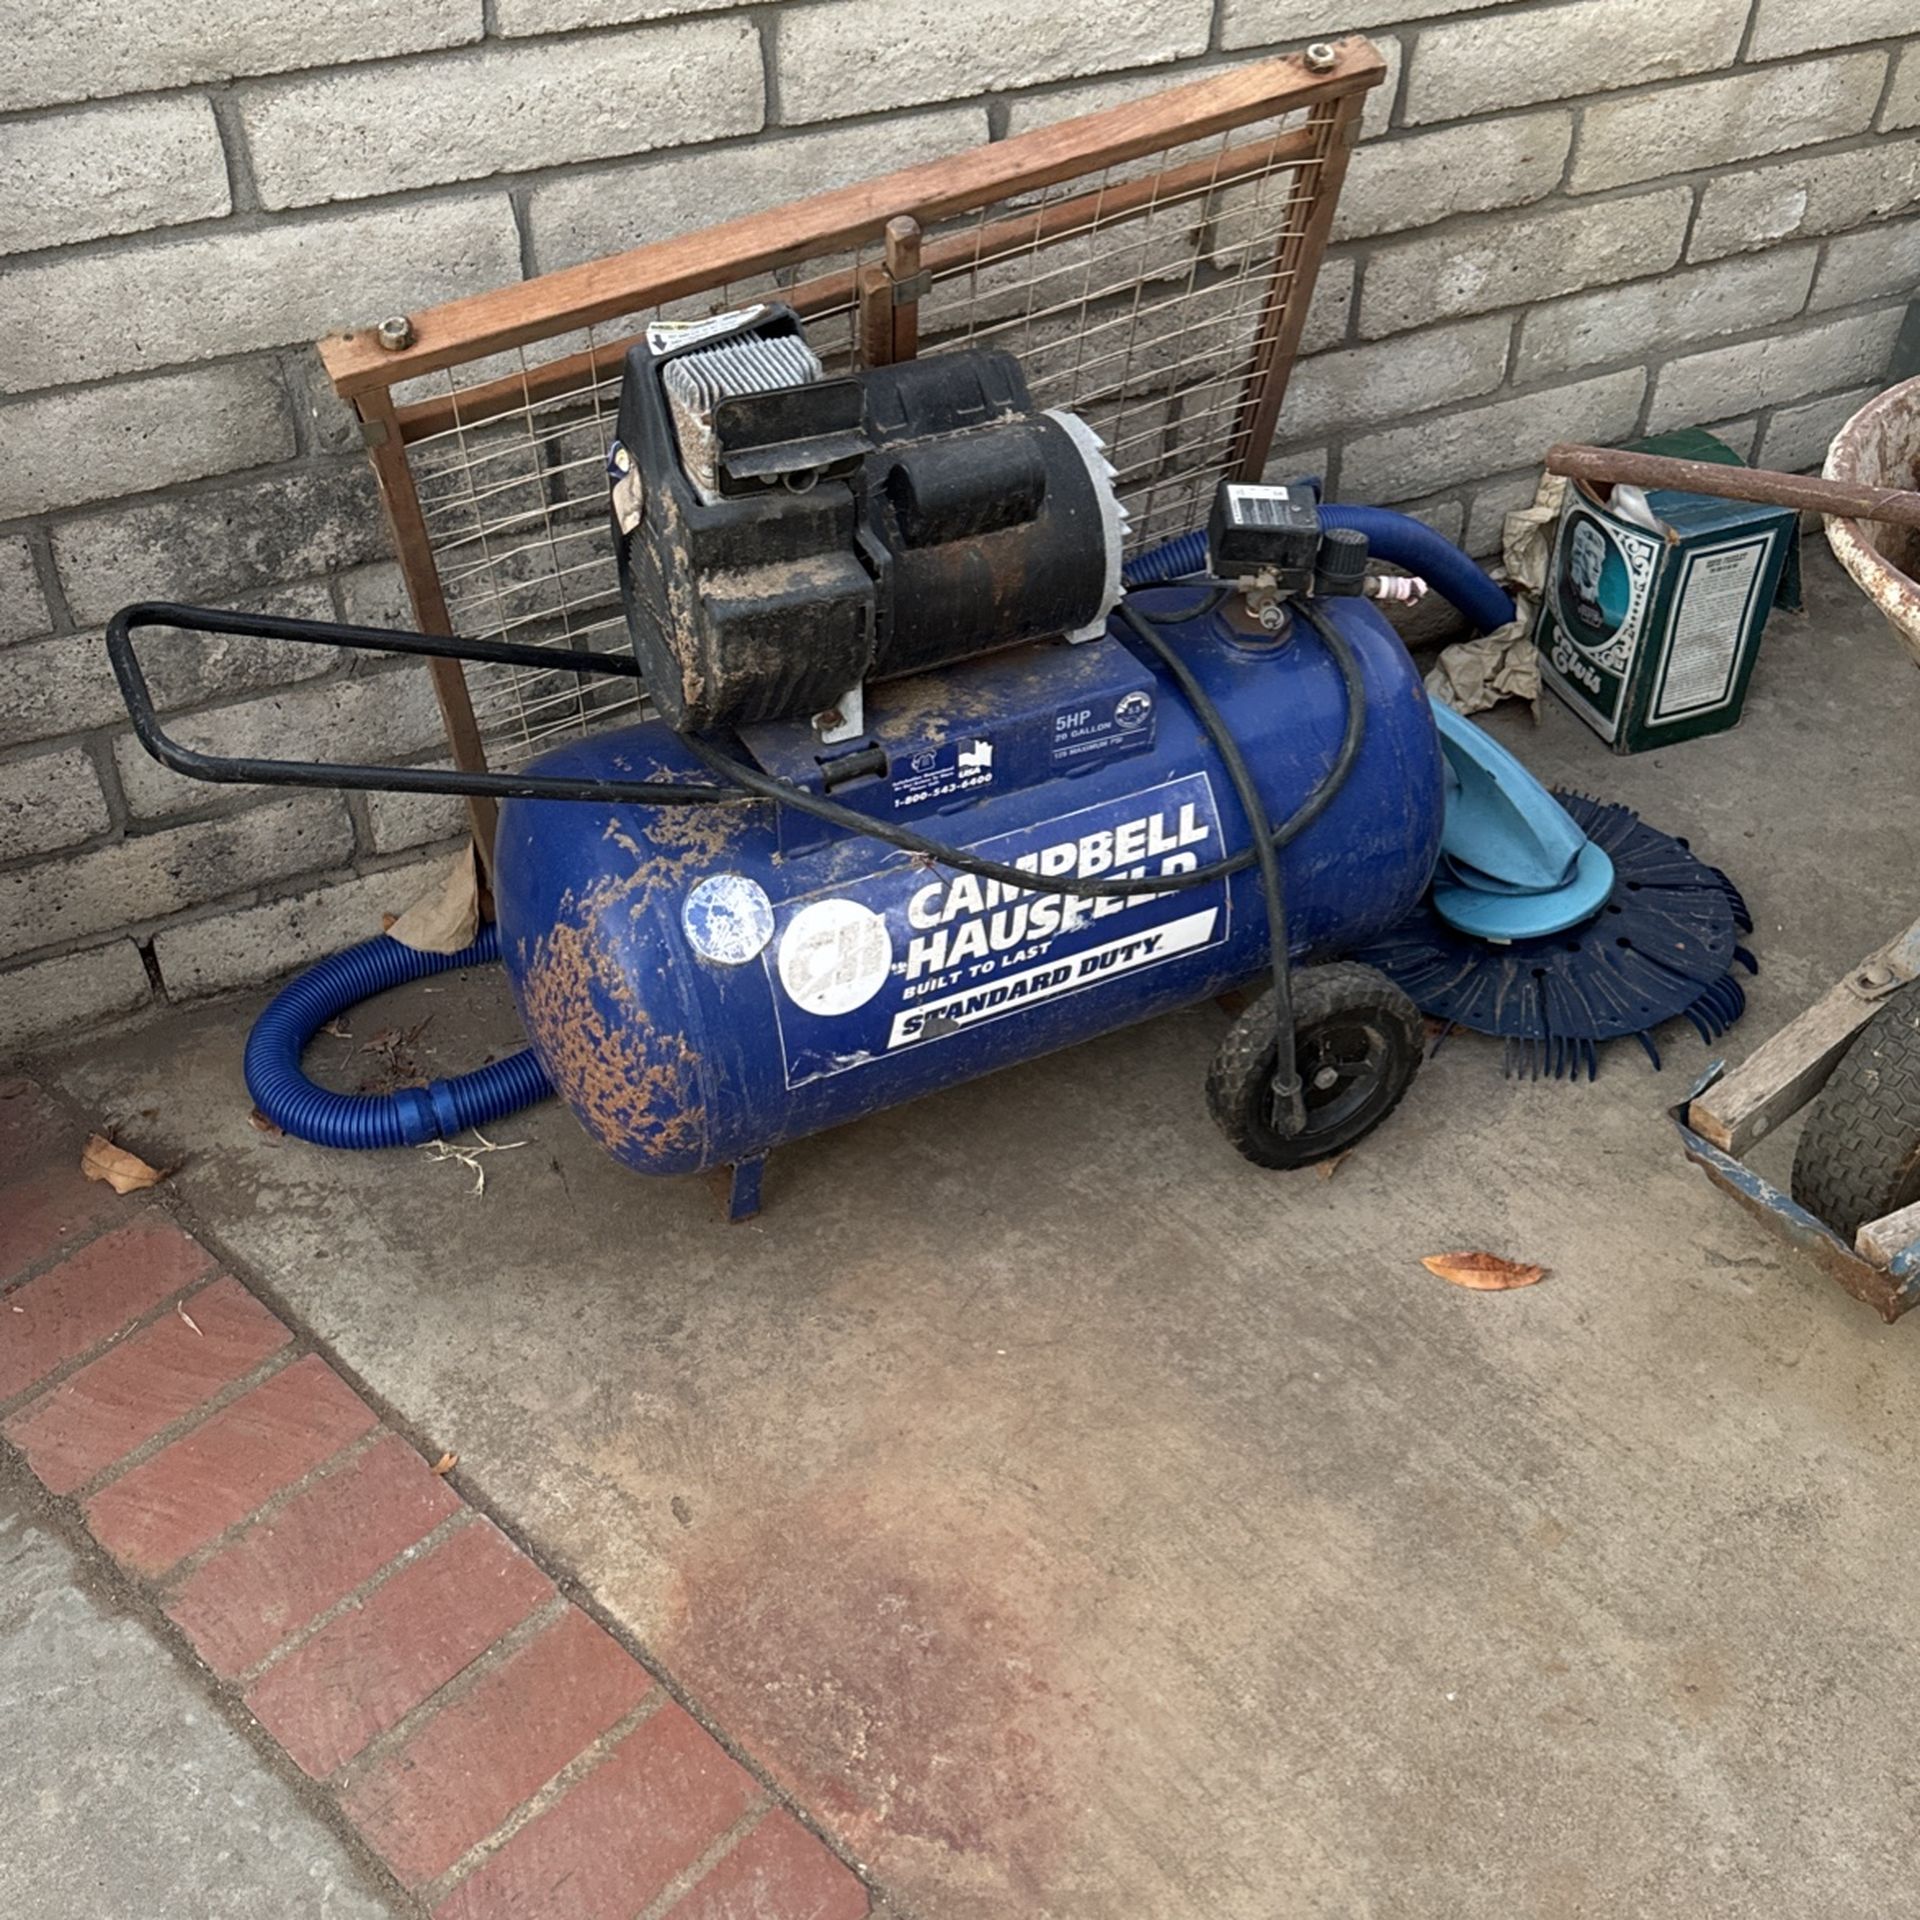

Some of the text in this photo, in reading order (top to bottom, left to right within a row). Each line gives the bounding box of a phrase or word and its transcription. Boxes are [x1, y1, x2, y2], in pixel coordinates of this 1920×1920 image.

[1552, 626, 1601, 694] Elvis
[1056, 709, 1092, 731] 5HP
[1070, 721, 1113, 738] GALLON
[894, 772, 993, 809] 1-800-543-6400
[908, 802, 1209, 930] CAMPBELL
[902, 942, 1053, 1001] BUILT TO LAST
